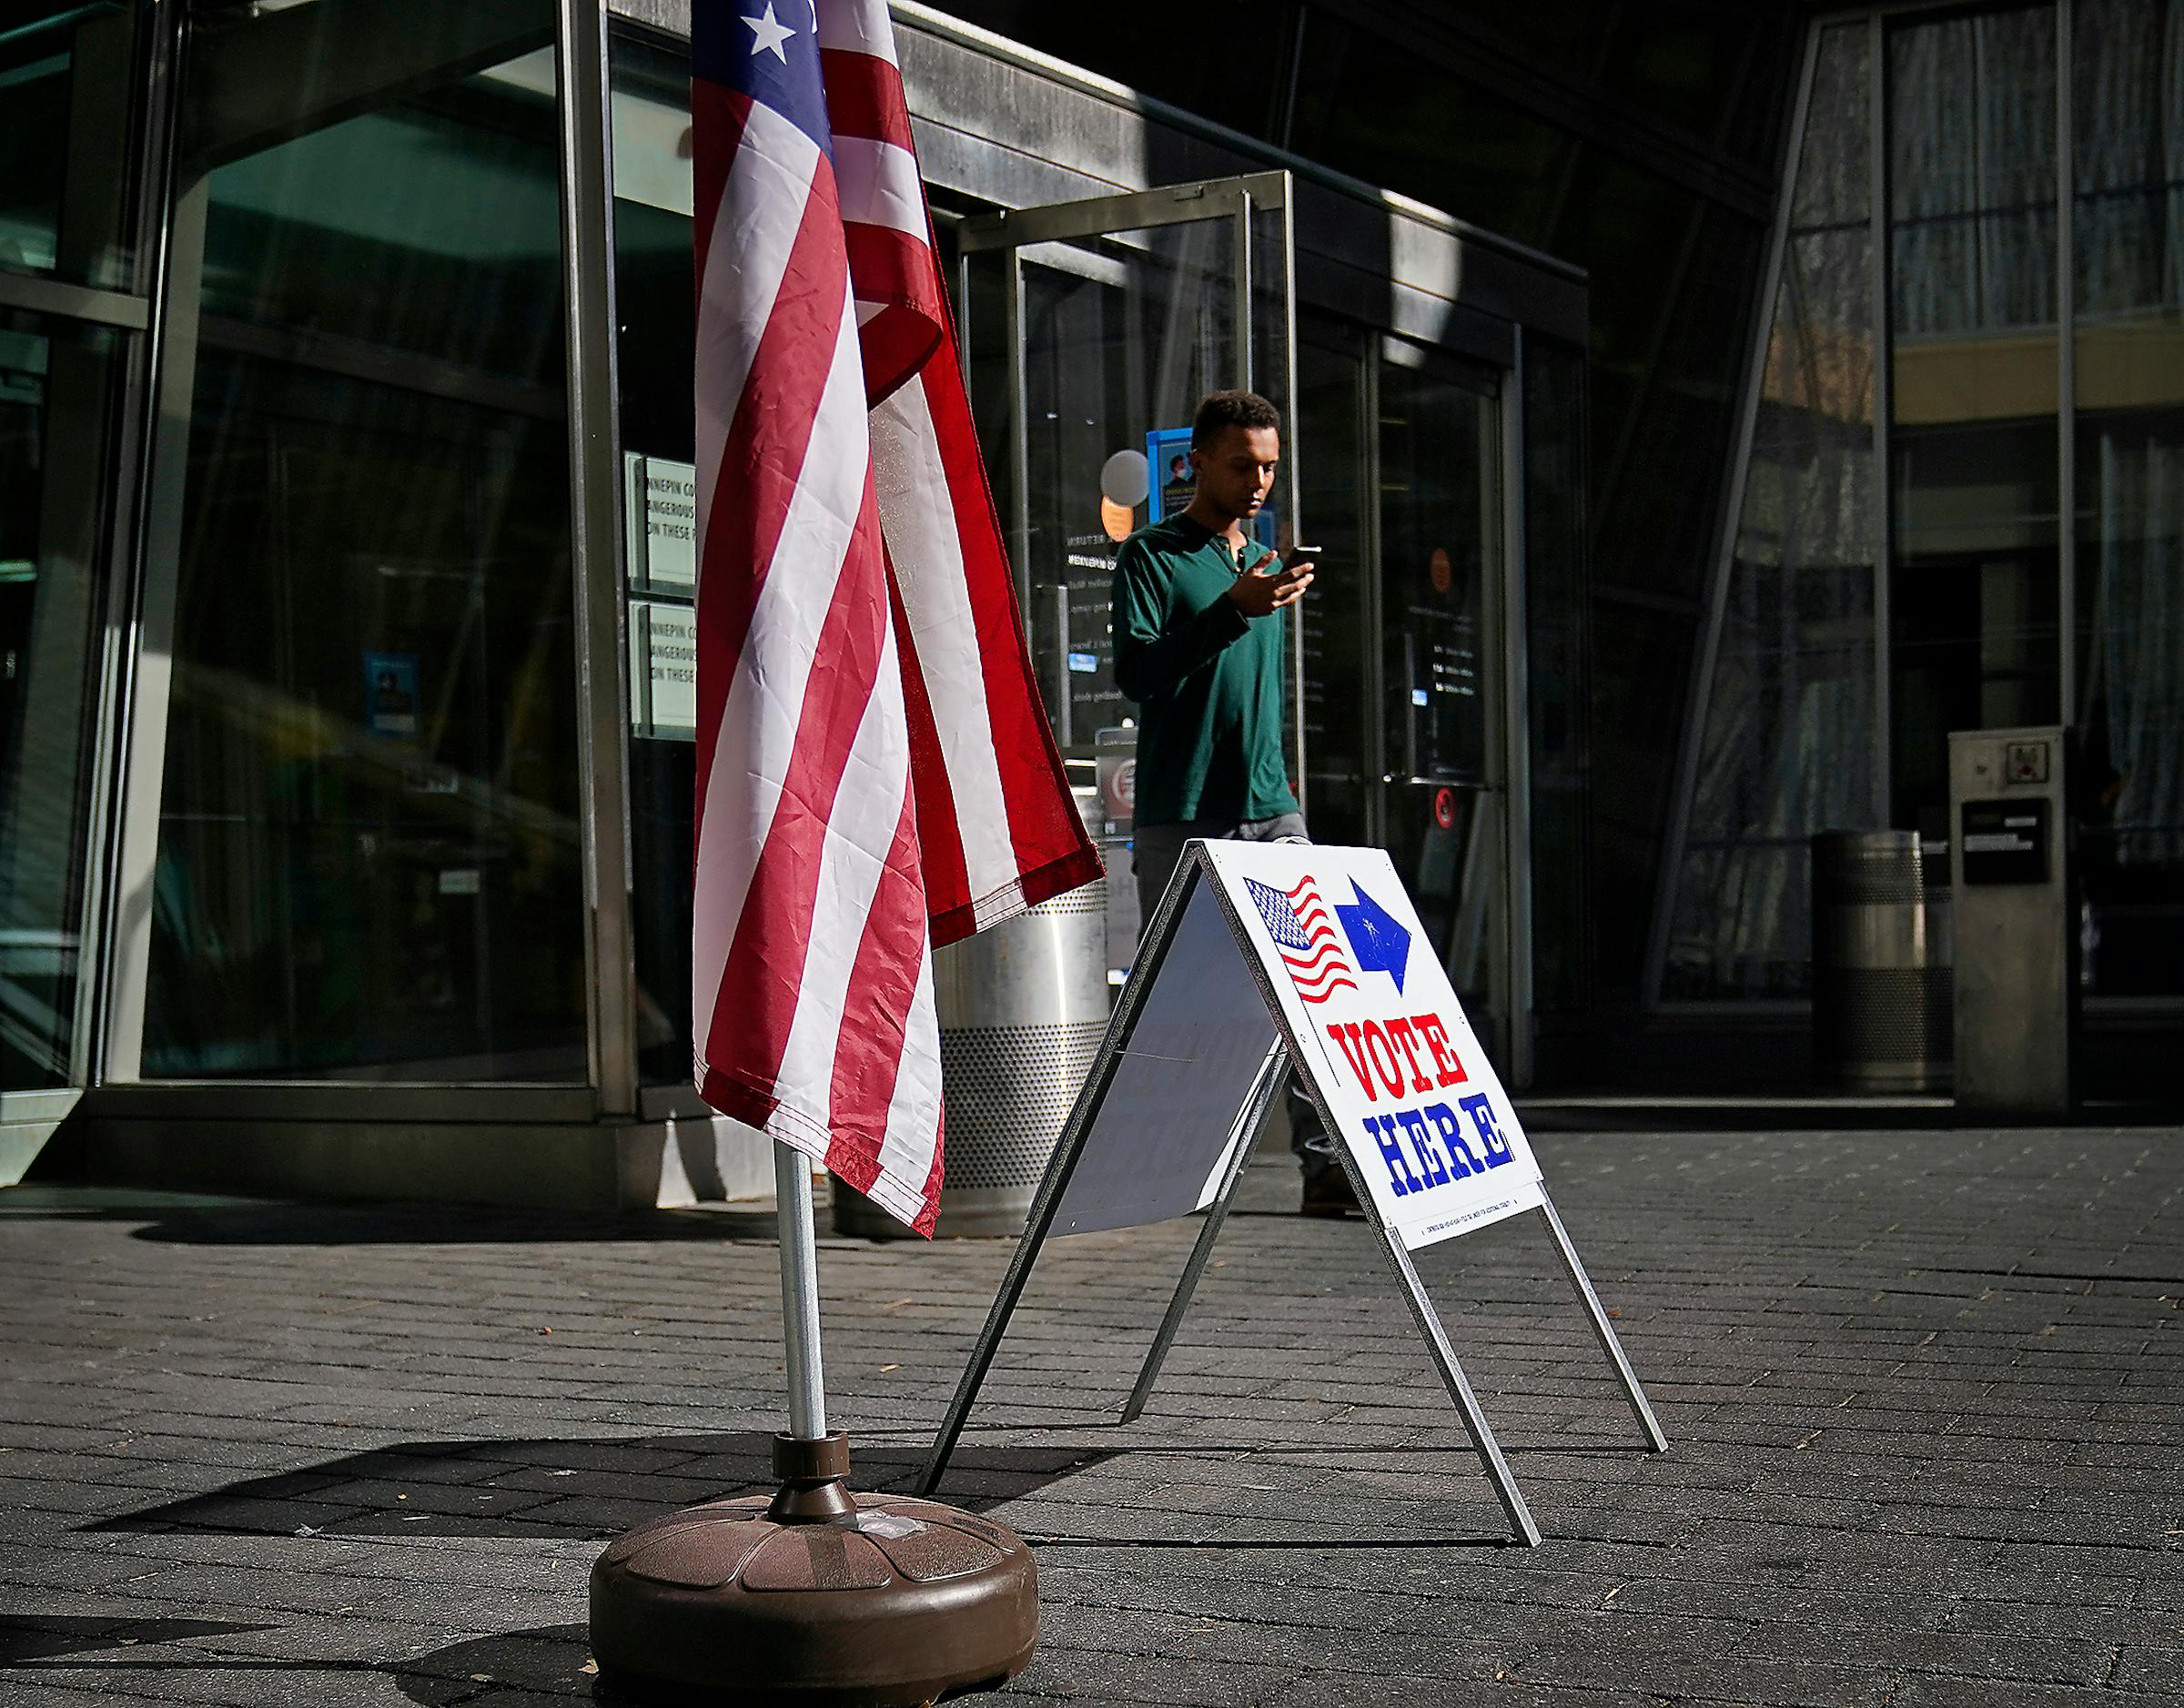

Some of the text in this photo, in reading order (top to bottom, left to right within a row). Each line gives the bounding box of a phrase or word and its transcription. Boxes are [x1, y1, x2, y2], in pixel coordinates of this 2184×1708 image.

[662, 523, 690, 540] THESE
[667, 667, 693, 683] THESE
[1326, 1013, 1468, 1101] VOTE
[1362, 1092, 1515, 1198] HERE
